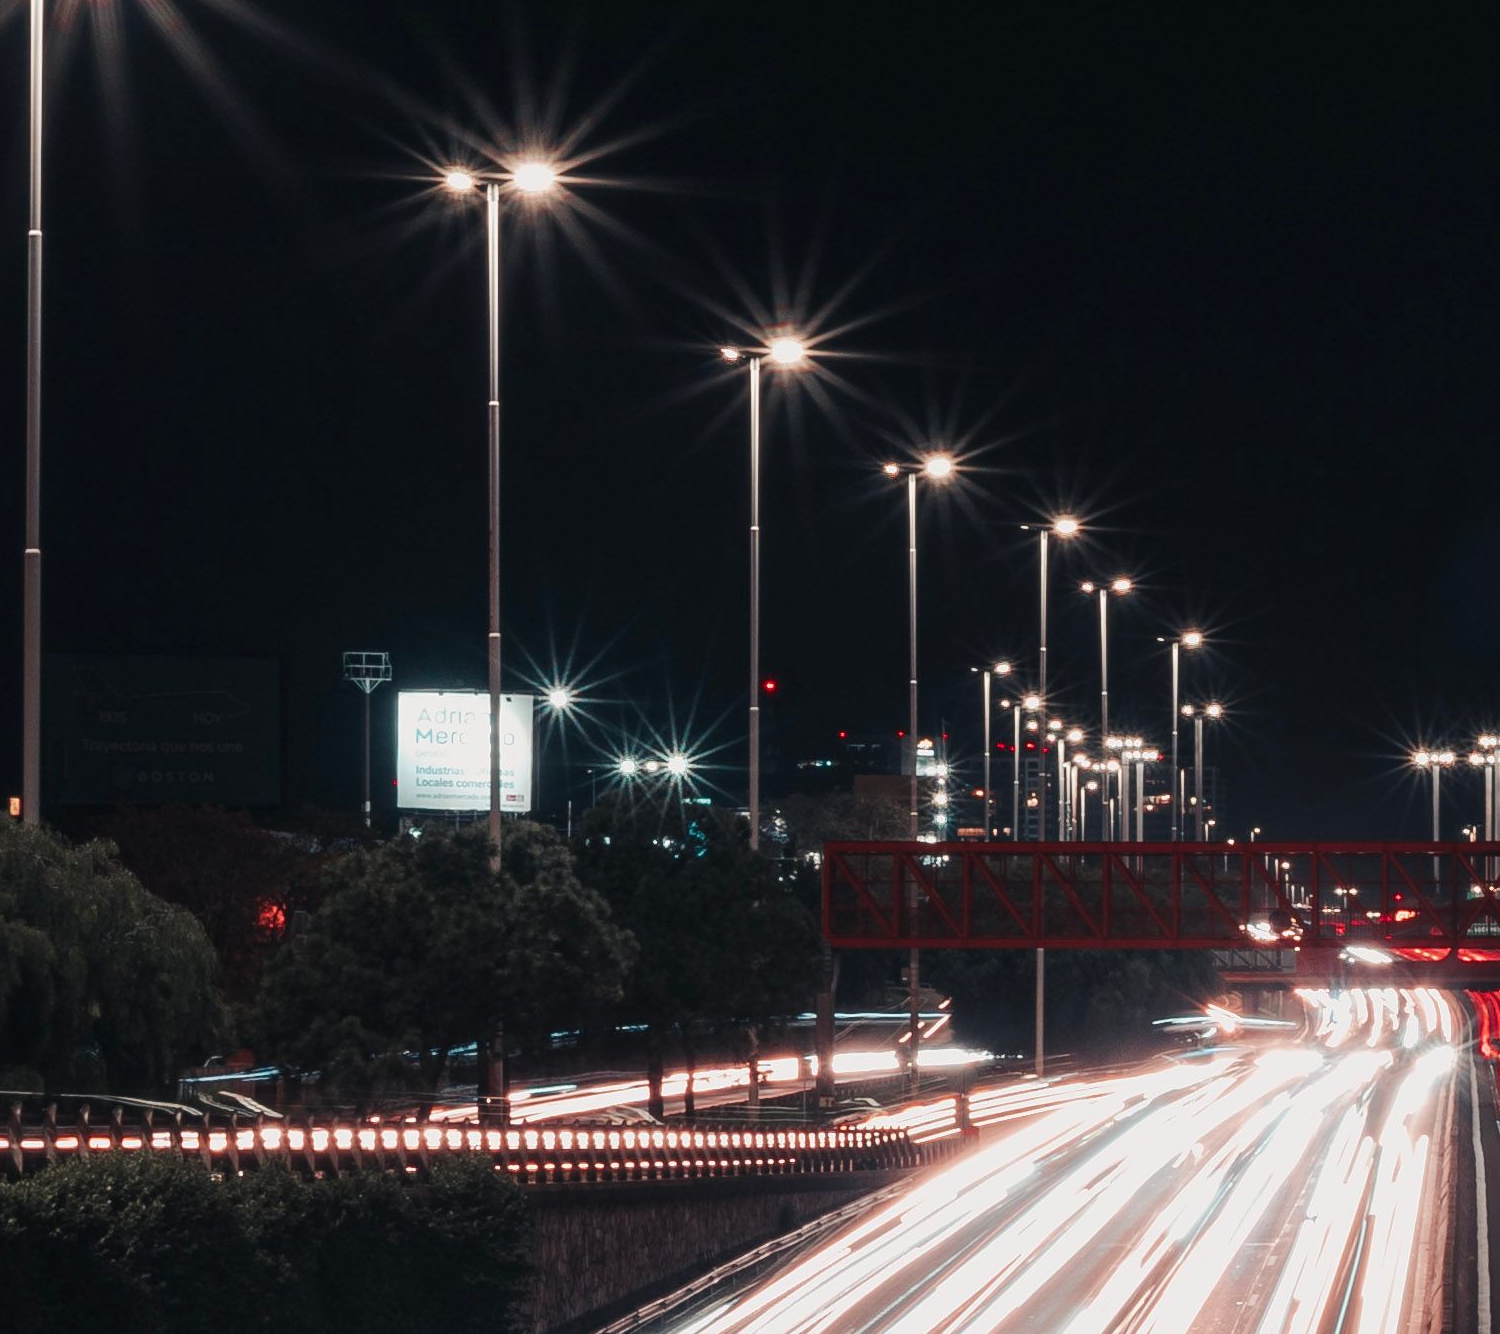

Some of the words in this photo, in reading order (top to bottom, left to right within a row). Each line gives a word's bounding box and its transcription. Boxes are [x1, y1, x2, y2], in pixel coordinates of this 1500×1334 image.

[193, 711, 222, 725] HOY
[415, 728, 515, 746] Merco
[81, 738, 156, 753] Trayectoria
[160, 742, 187, 755] que
[189, 742, 214, 753] nos
[216, 742, 242, 753] une
[137, 771, 214, 783] BOSTON
[416, 777, 453, 788] Locales
[456, 779, 515, 789] comercles
